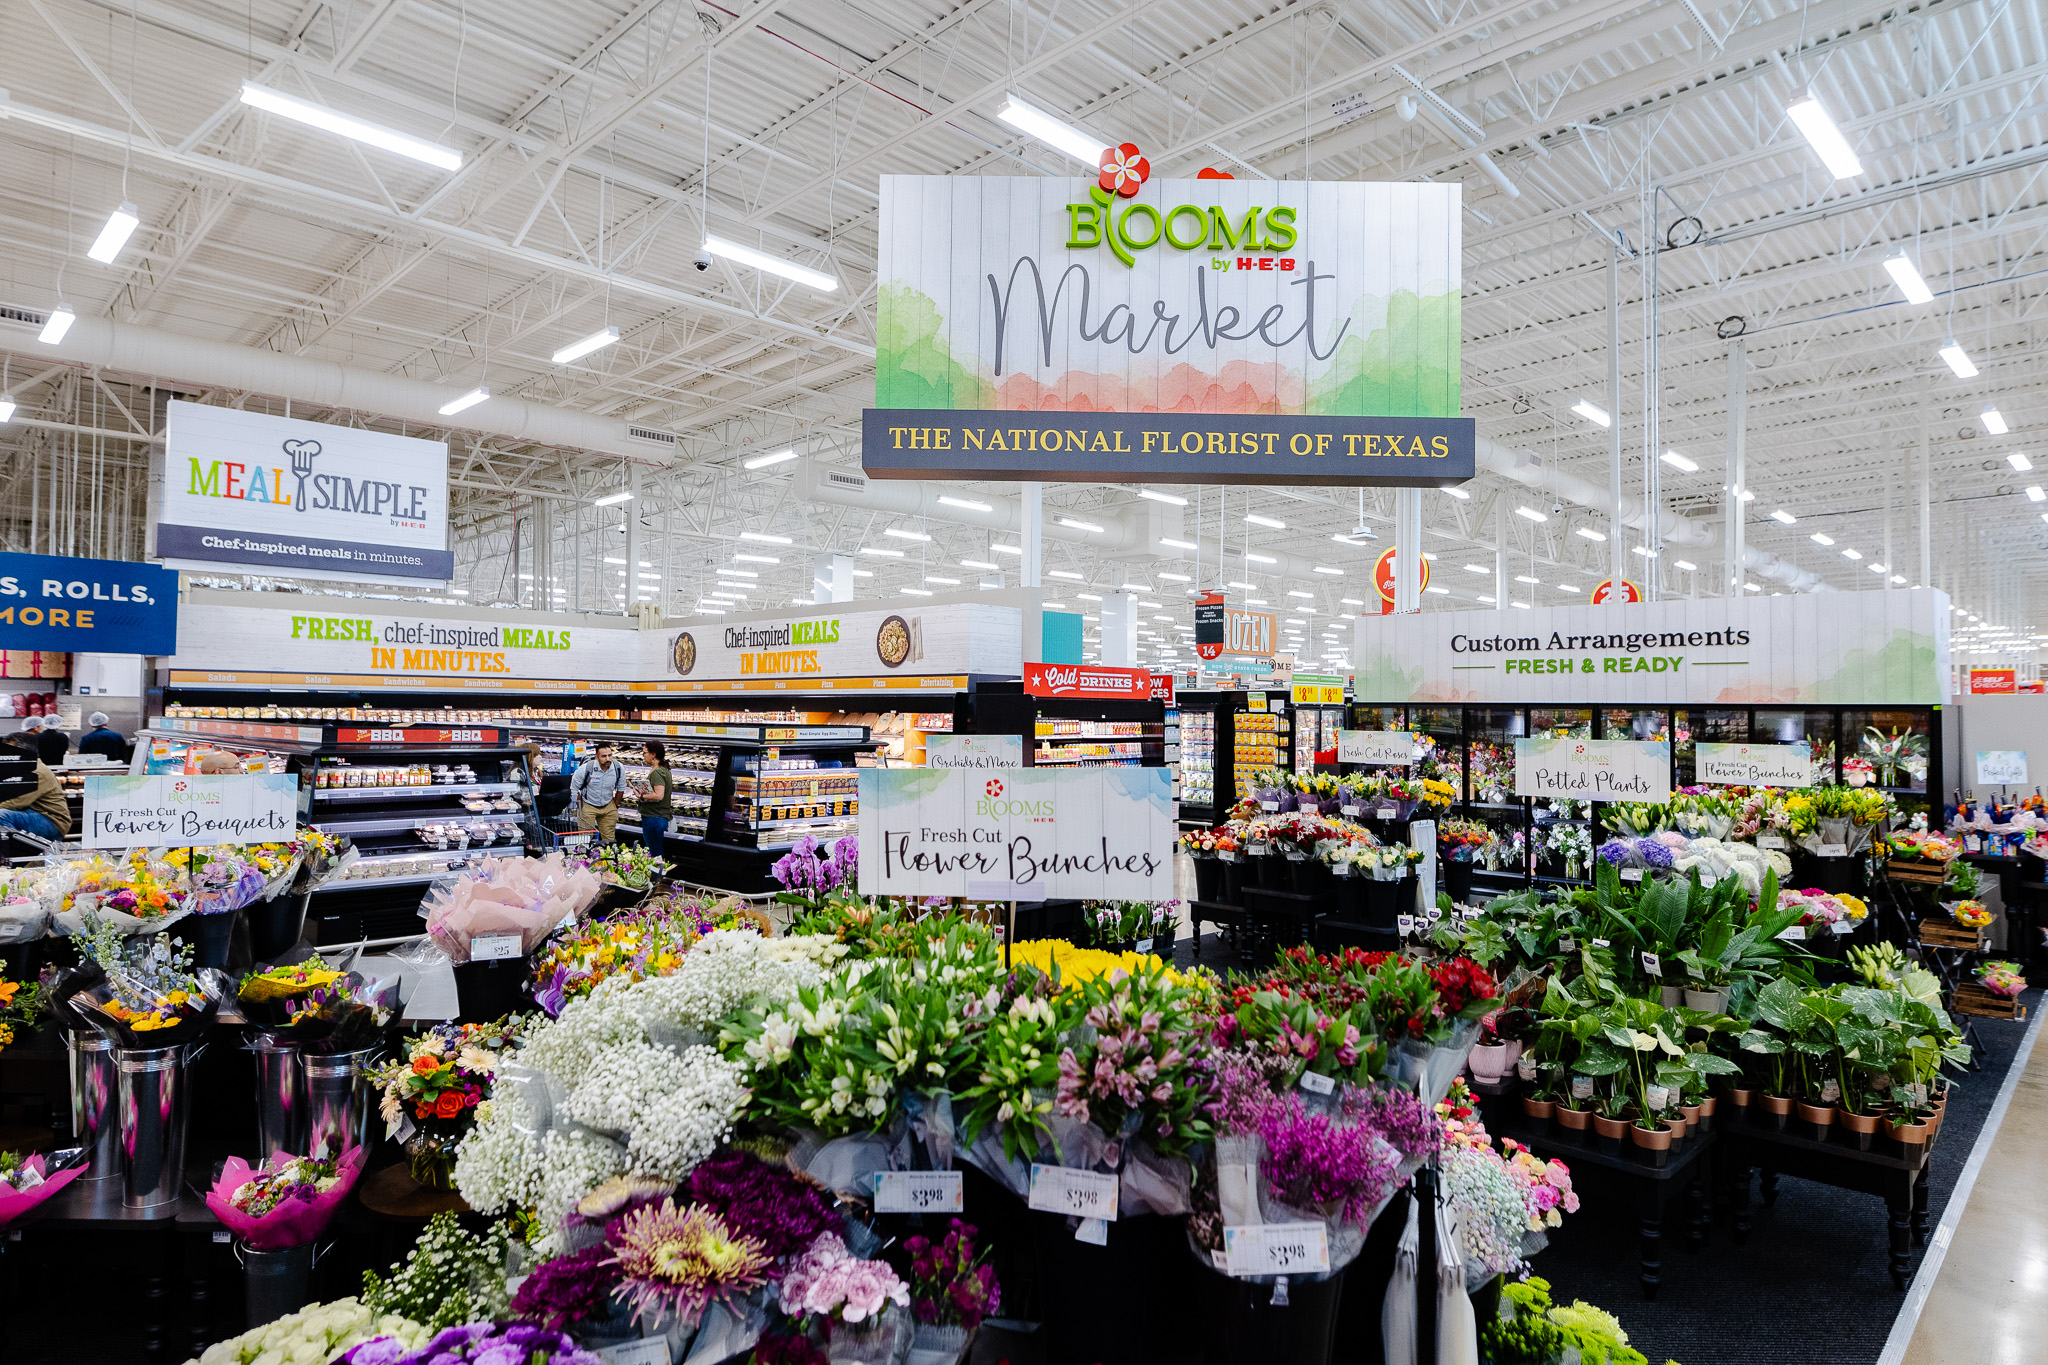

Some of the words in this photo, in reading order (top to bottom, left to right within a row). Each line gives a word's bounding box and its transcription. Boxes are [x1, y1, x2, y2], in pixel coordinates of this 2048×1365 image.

[1066, 200, 1298, 267] BLOOMS
[1212, 258, 1231, 273] by
[987, 255, 1352, 376] Market
[889, 427, 952, 452] THE
[961, 428, 1131, 454] NATIONAL
[1141, 431, 1280, 457] FLORIST
[1289, 433, 1332, 457] OF
[1343, 434, 1450, 460] TEXAS
[187, 457, 291, 506] MEAL
[313, 474, 428, 521] SIMPLE
[390, 519, 399, 528] by
[202, 535, 307, 557] Chef-inspired
[309, 545, 351, 560] meals
[354, 549, 367, 561] in
[370, 552, 424, 566] minutes.
[42, 579, 155, 606] ROLLS,
[291, 616, 379, 645] FRESH,
[384, 622, 498, 649] chef-inspired
[502, 628, 571, 650] MEALS
[725, 623, 789, 650] Chef-inspired
[791, 620, 840, 645] MEALS
[1223, 612, 1270, 653] ROZEN
[1451, 634, 1541, 653] Custom
[1546, 626, 1750, 653] Arrangements
[371, 648, 396, 669] IN
[403, 648, 510, 673] MINUTES.
[740, 653, 754, 674] IN
[757, 650, 821, 674] MINUTES.
[1202, 645, 1216, 657] 14
[1506, 658, 1573, 674] FRESH
[1581, 658, 1595, 673] &
[1604, 656, 1683, 673] READY
[208, 673, 237, 682] Salads
[305, 676, 331, 684] Salads
[383, 678, 426, 686] Sandwiches
[464, 679, 503, 687] Sandwiches
[534, 681, 557, 689] Chicken
[557, 681, 577, 689] Salads
[589, 682, 610, 690] Chicken
[920, 678, 954, 687] Entertaining
[1045, 667, 1078, 688] Cold
[1080, 676, 1132, 688] DRINKS
[370, 729, 404, 741] BBQ
[452, 729, 482, 741] BBQ
[931, 754, 975, 768] Orchids
[975, 757, 986, 768] &
[986, 754, 1018, 768] More
[1343, 745, 1363, 758] Fresh
[1365, 746, 1383, 759] Cut
[1385, 747, 1408, 760] Roses
[1571, 751, 1609, 764] BLOOMS
[1535, 768, 1590, 790] Potted
[1595, 770, 1651, 793] Plants
[1705, 762, 1747, 777] Flower
[1749, 765, 1803, 780] Bunches
[168, 790, 220, 805] BLOOMS
[976, 795, 1055, 822] BLOOMS
[94, 810, 174, 838] Flower
[182, 809, 290, 837] Bouquets
[120, 808, 153, 817] Fresh
[156, 808, 177, 817] Cut
[920, 828, 967, 843] Fresh
[973, 828, 1002, 843] Cut
[885, 830, 998, 879] Flower
[1008, 836, 1161, 884] Bunches
